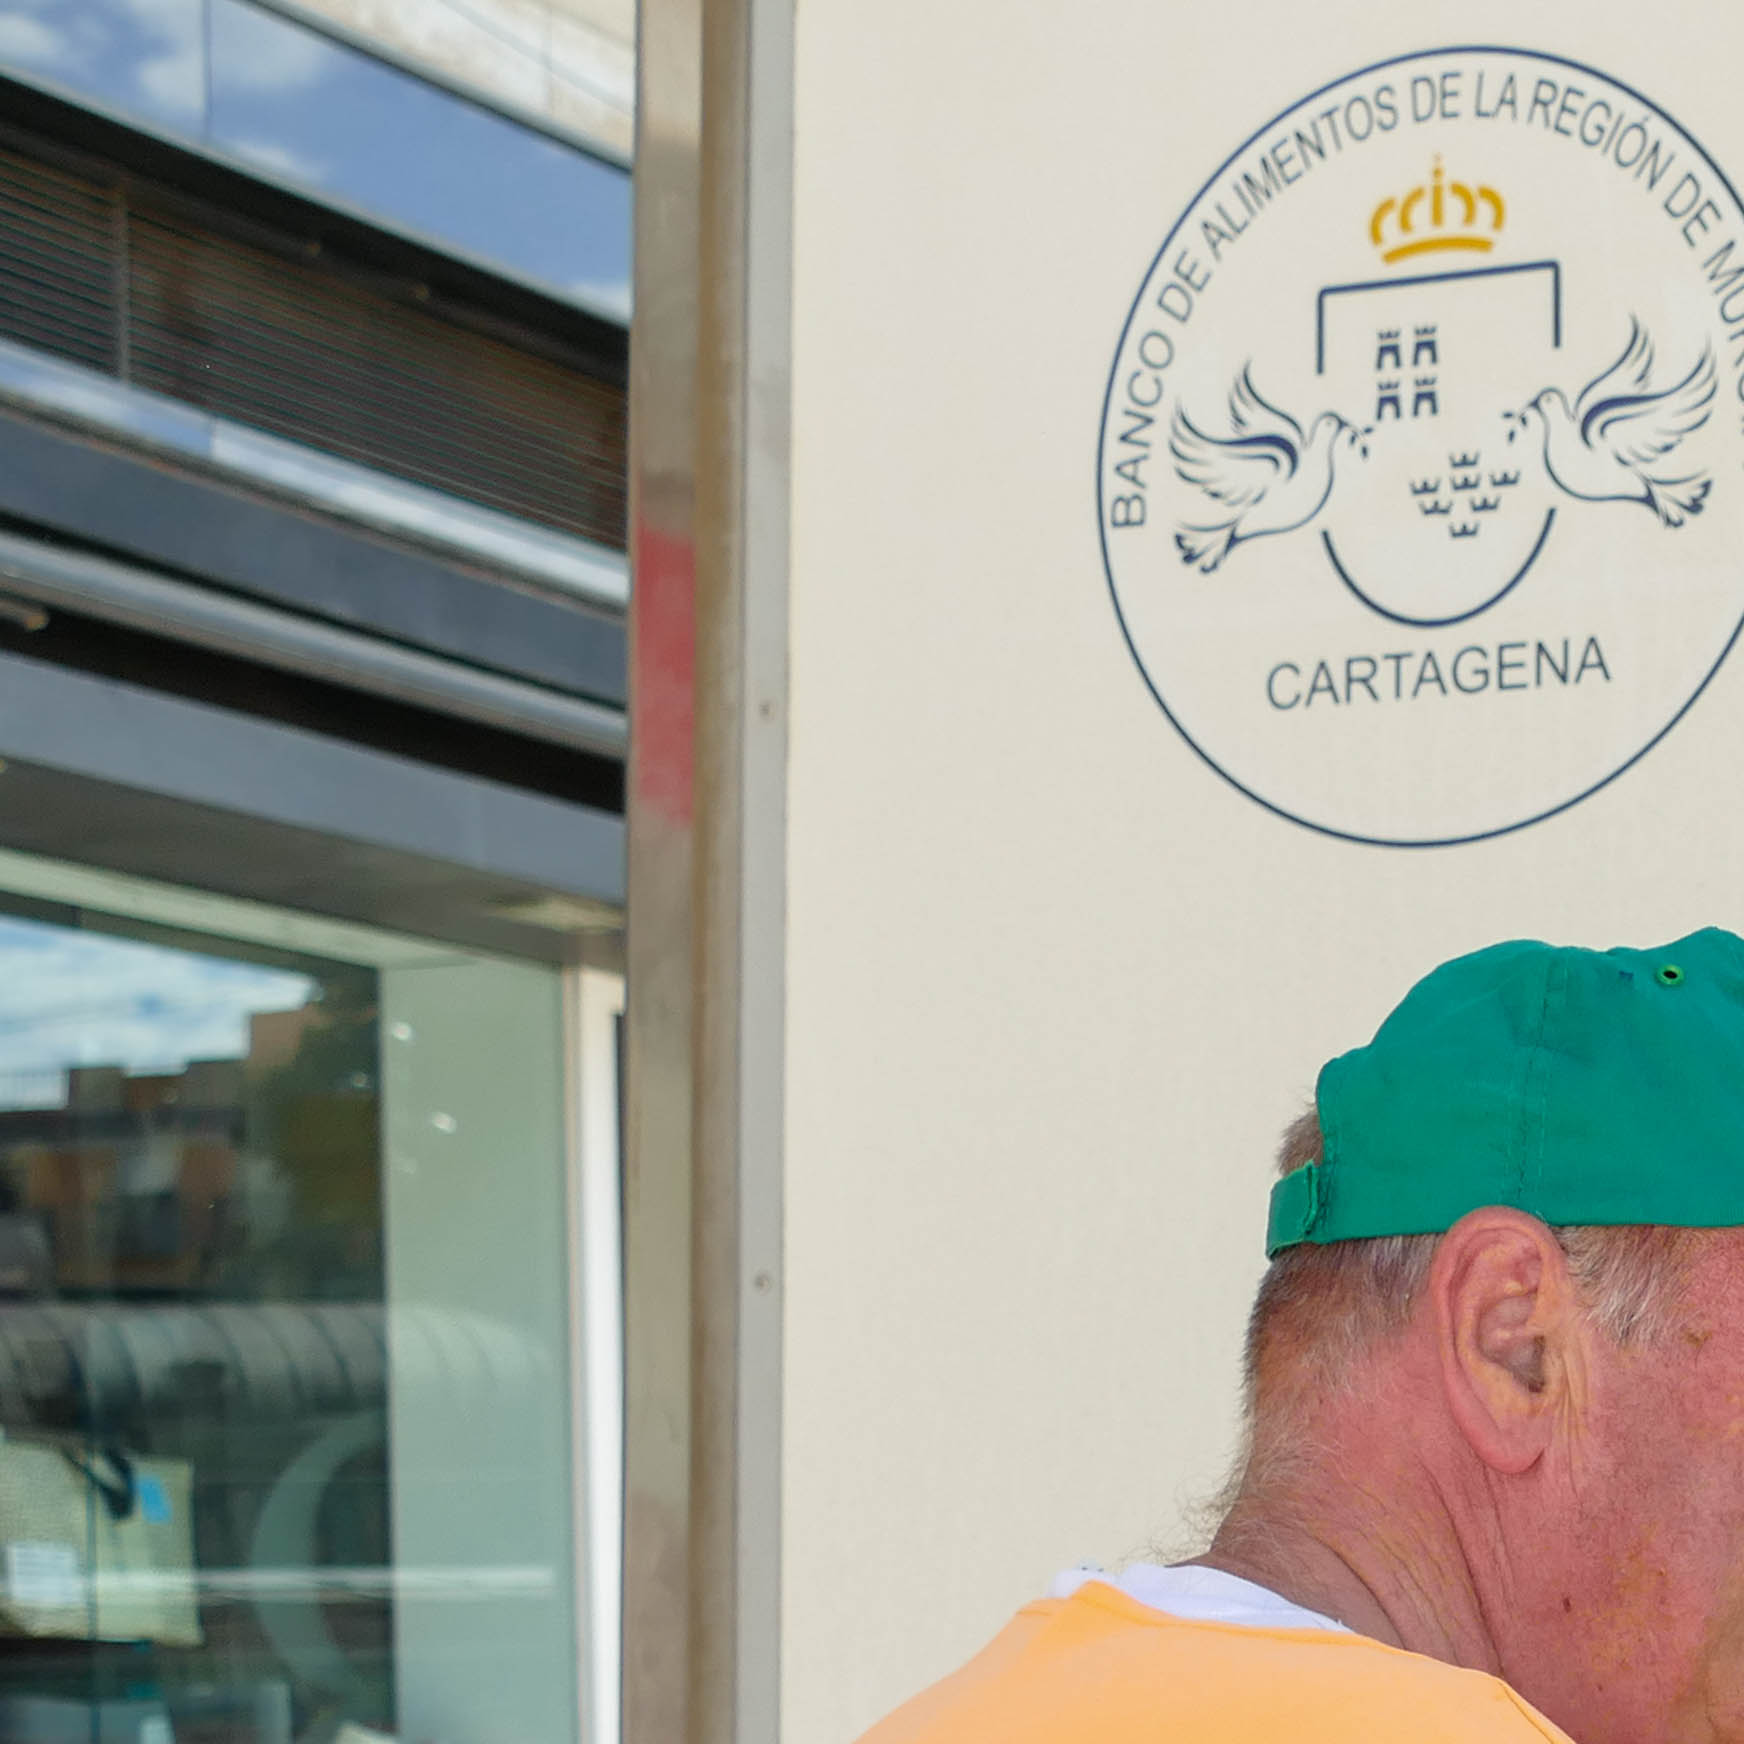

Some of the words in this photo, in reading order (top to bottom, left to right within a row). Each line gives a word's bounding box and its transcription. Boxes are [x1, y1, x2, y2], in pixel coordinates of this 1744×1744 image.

[1111, 328, 1176, 528] BANCO
[1156, 266, 1216, 325] DE
[1204, 85, 1400, 264] ALIMENTOS
[1410, 71, 1462, 122] DE
[1475, 70, 1519, 118] LA
[1527, 75, 1676, 192] REGIÓN
[1663, 175, 1725, 248] DE
[1266, 635, 1612, 711] CARTAGENA
